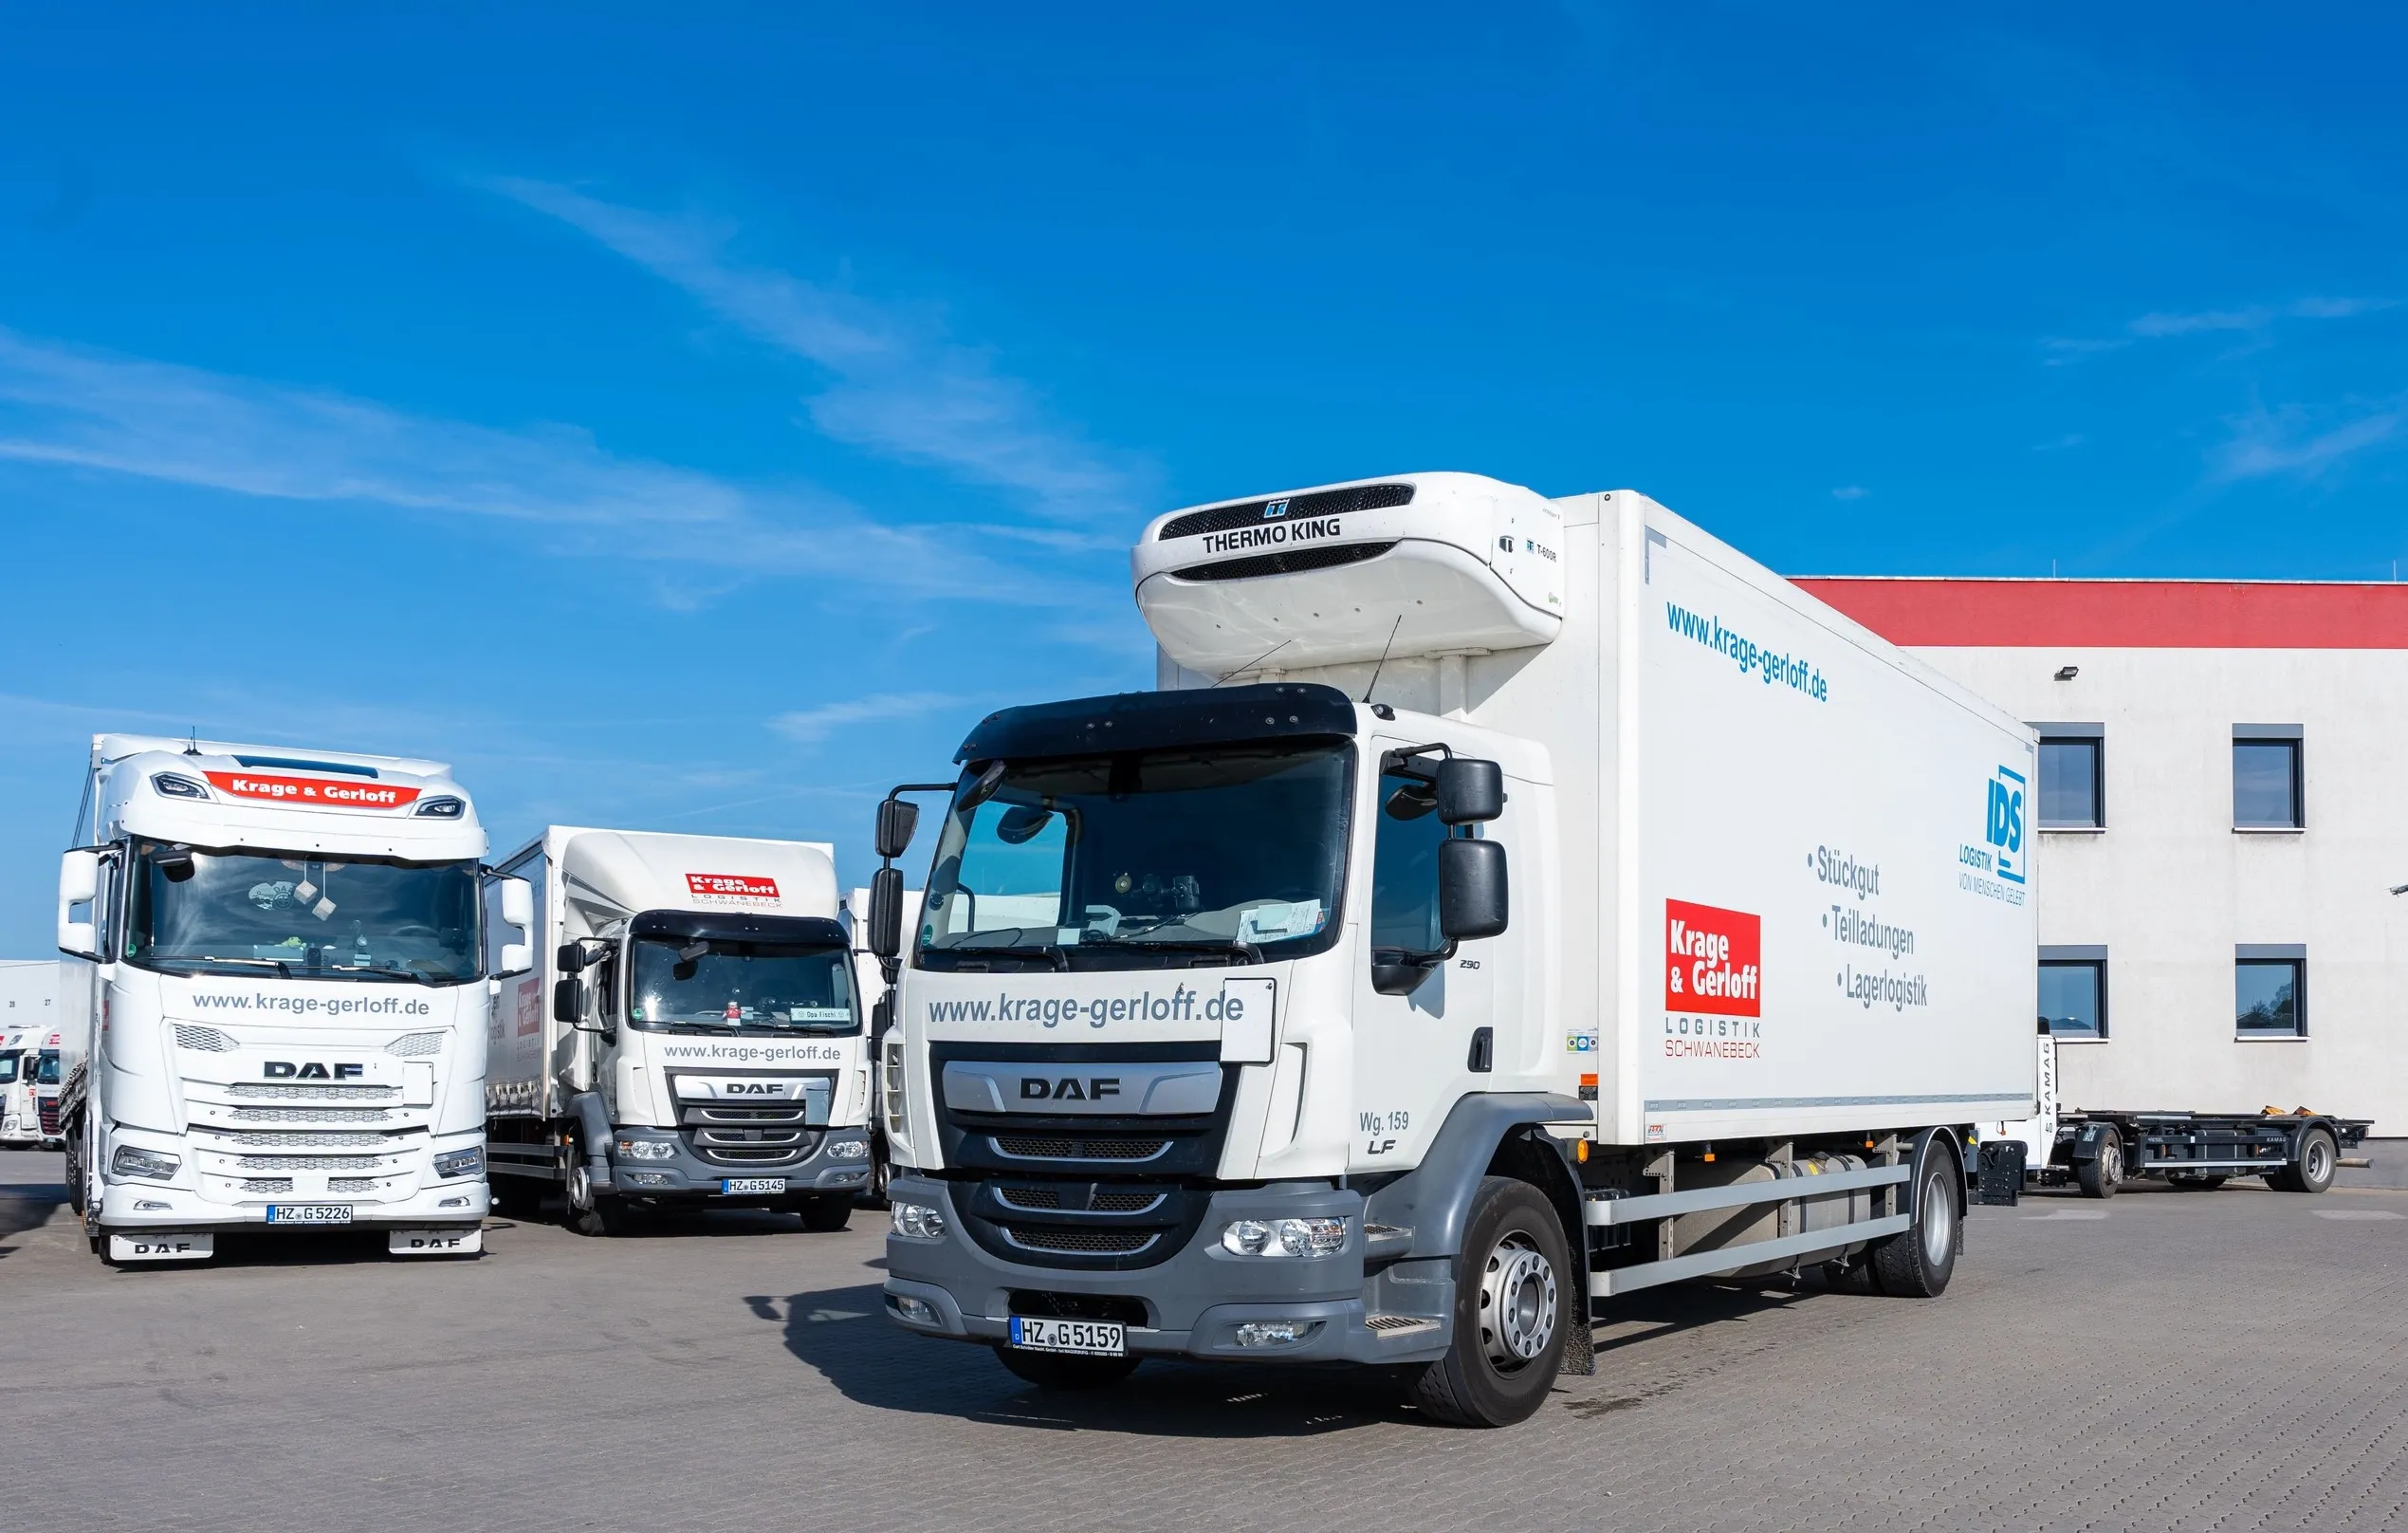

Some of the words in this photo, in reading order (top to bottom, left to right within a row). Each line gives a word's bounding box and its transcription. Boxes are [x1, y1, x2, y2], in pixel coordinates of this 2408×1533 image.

[1203, 526, 1286, 553] THERMO
[1292, 518, 1340, 542] KING
[1666, 600, 1828, 702] www.krage-gerloff.de
[232, 779, 298, 797] Krage
[303, 786, 317, 796] &
[323, 786, 396, 803] Gerloff
[1986, 778, 2022, 853] IDS
[1958, 843, 1993, 872] LOGISTIK
[689, 876, 744, 886] Krage
[1817, 844, 1880, 900] Stückgut
[691, 894, 781, 902] LOGISTIK
[711, 883, 775, 894] Gerloff
[1958, 873, 1973, 891] VON
[1974, 877, 2005, 901] MENSCHEN
[2006, 887, 2026, 906] GELEBT
[692, 898, 783, 908] SCHWANEBECK
[1831, 904, 1914, 960] Teilladungen
[1670, 918, 1729, 969] Krage
[1460, 959, 1480, 970] 290
[1670, 966, 1683, 993] &
[1692, 960, 1757, 1000] Gerloff
[1847, 963, 1927, 1012] Lagerlogistik
[193, 992, 430, 1016] www.krage-gerloff.de
[928, 989, 1244, 1028] www.krage-gerloff.de
[1665, 1016, 1760, 1039] LOGISTIK
[664, 1044, 841, 1062] www.krage-gerloff.de
[1665, 1040, 1760, 1059] SCHWANEBECK
[264, 1062, 363, 1080] DAF
[2043, 1042, 2051, 1116] KAMAG
[726, 1083, 783, 1094] DAF
[1020, 1078, 1121, 1100] DAF
[1359, 1112, 1384, 1136] Wg.
[1388, 1111, 1408, 1130] 159
[1368, 1139, 1396, 1154] LF
[729, 1180, 744, 1191] HZ
[276, 1208, 295, 1220] HZ
[135, 1243, 190, 1254] DAF
[411, 1239, 460, 1248] DAF
[1021, 1321, 1045, 1343] HZ
